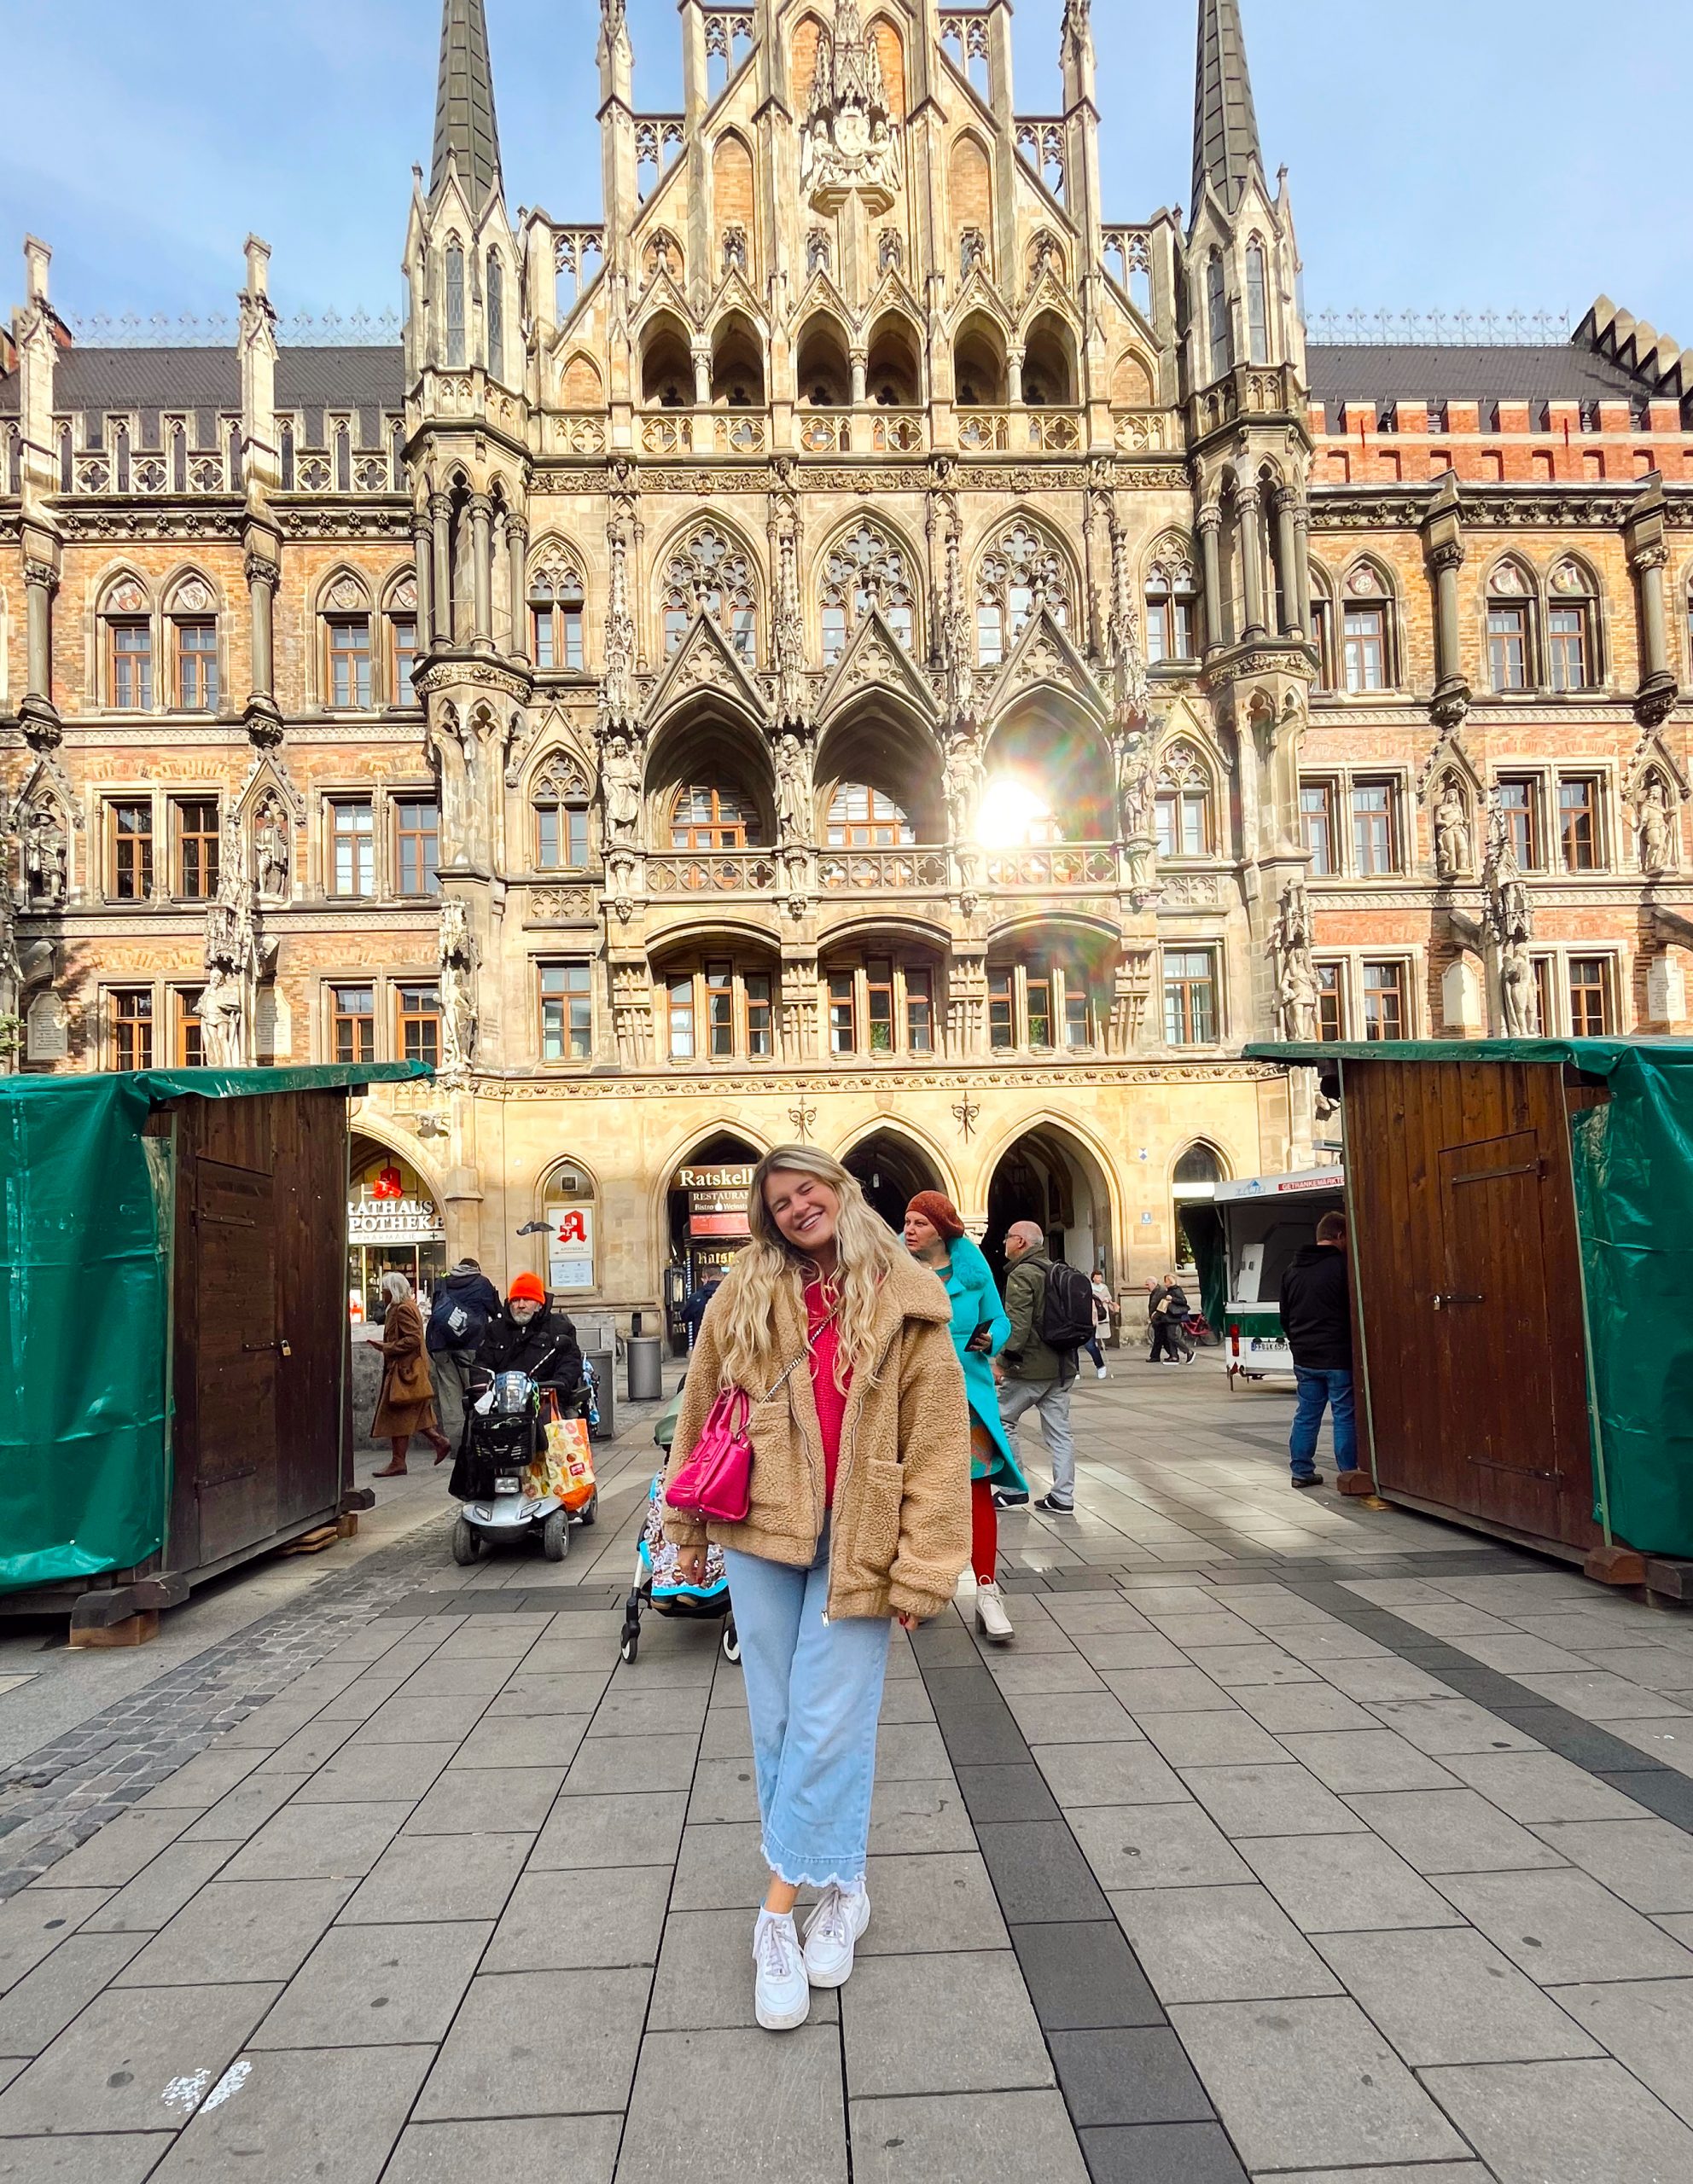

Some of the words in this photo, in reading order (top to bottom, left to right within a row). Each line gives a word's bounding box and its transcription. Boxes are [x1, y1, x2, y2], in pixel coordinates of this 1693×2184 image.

[679, 1168, 753, 1187] Ratskell
[695, 1203, 714, 1211] Bistro
[357, 1233, 417, 1241] PHARMACIE
